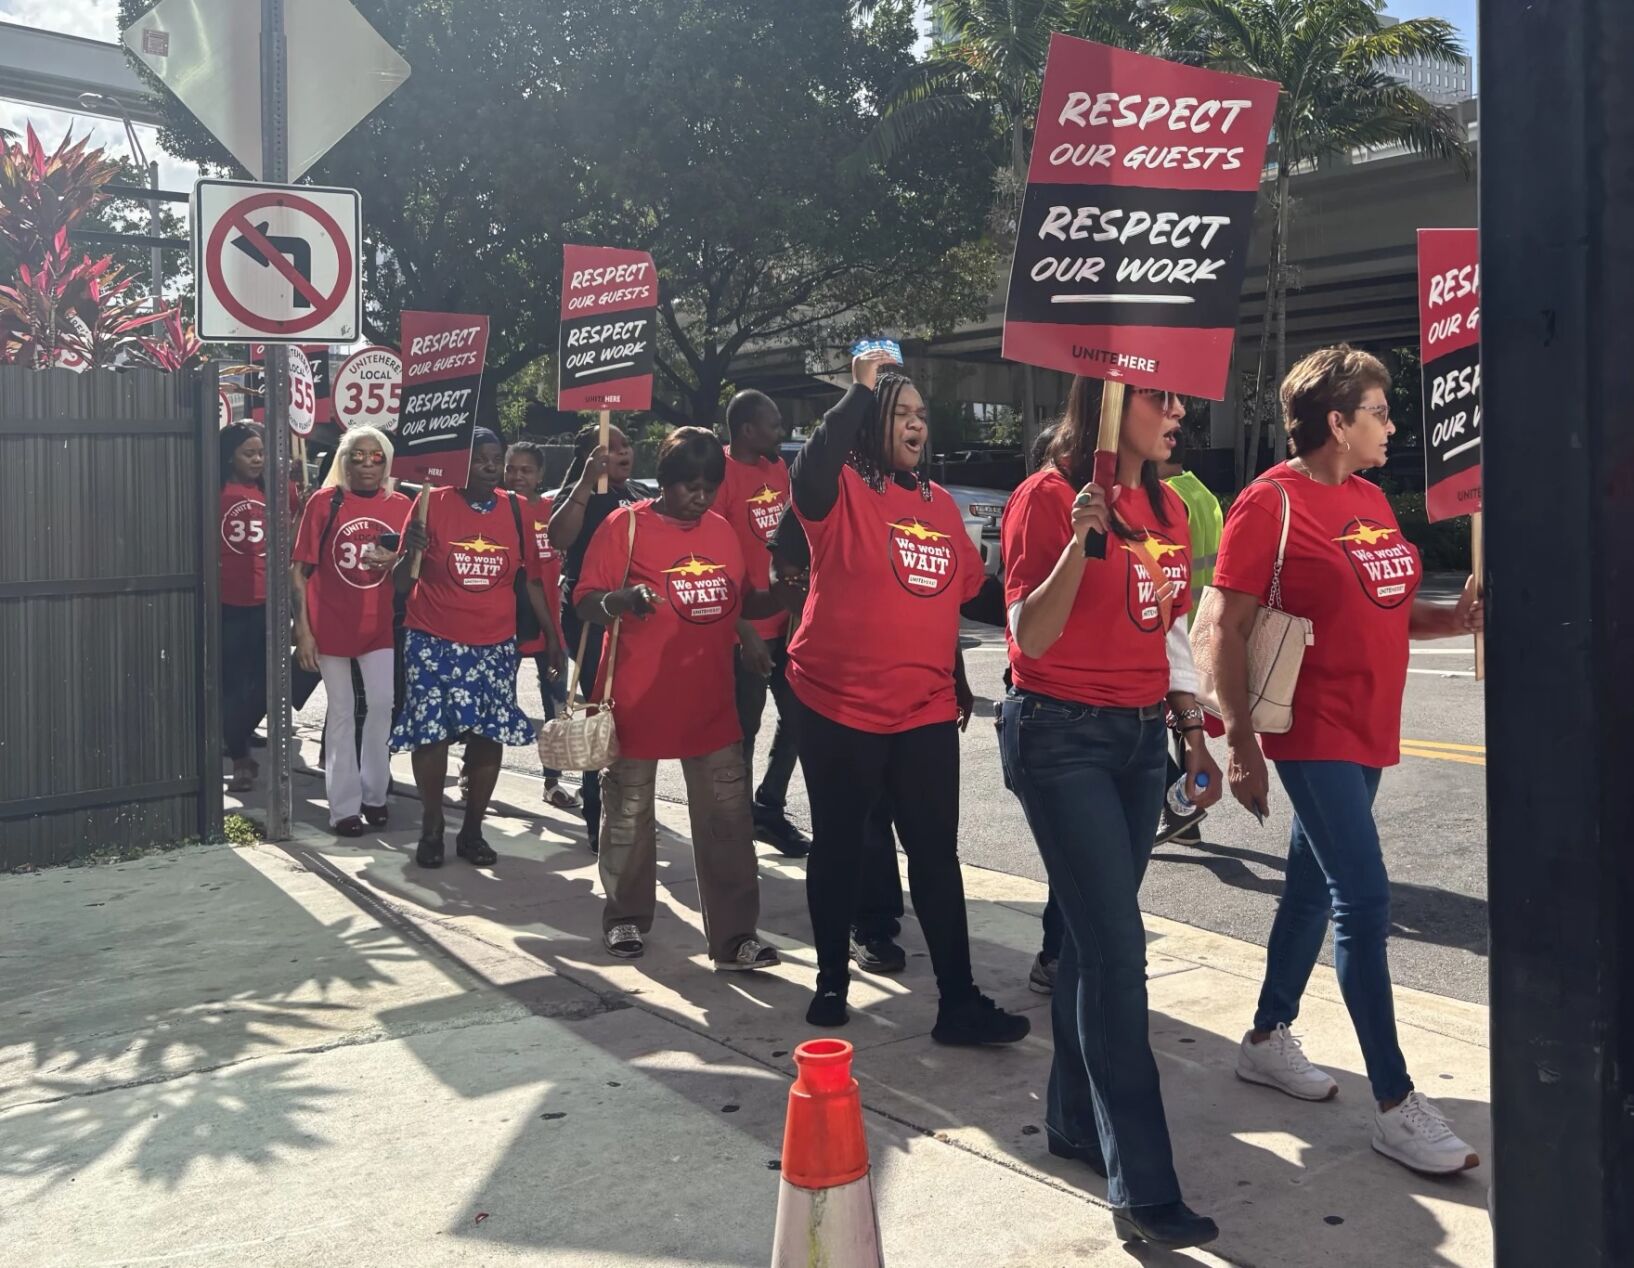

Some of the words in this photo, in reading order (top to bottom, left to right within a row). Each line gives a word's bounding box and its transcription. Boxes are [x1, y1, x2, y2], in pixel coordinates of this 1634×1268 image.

[1058, 92, 1251, 133] RESPECT
[1049, 144, 1116, 167] OUR
[1123, 146, 1244, 170] GUESTS
[1039, 206, 1230, 249] RESPECT
[570, 262, 649, 290] RESPECT
[1031, 256, 1105, 282] OUR
[1116, 258, 1226, 283] WORK
[568, 294, 595, 310] OUR
[598, 285, 649, 305] GUESTS
[410, 327, 480, 356] RESPECT
[567, 320, 647, 348] RESPECT
[1428, 313, 1462, 344] OUR
[408, 361, 432, 377] OUR
[433, 351, 477, 371] GUESTS
[566, 350, 595, 369] OUR
[600, 341, 647, 361] WORK
[360, 370, 392, 380] LOCAL
[343, 382, 401, 415] 355
[405, 388, 472, 414] RESPECT
[402, 419, 426, 436] OUR
[429, 411, 469, 431] WORK
[1432, 411, 1466, 447] OUR
[454, 553, 471, 562] We
[473, 556, 503, 565] won't
[895, 537, 915, 550] We
[917, 544, 951, 559] won't
[1351, 549, 1375, 562] We
[1374, 543, 1411, 559] won't
[455, 562, 501, 576] WAIT
[899, 550, 949, 575] WAIT
[1362, 556, 1414, 581] WAIT
[672, 580, 692, 590] We
[694, 577, 727, 588] won't
[677, 587, 728, 604] WAIT
